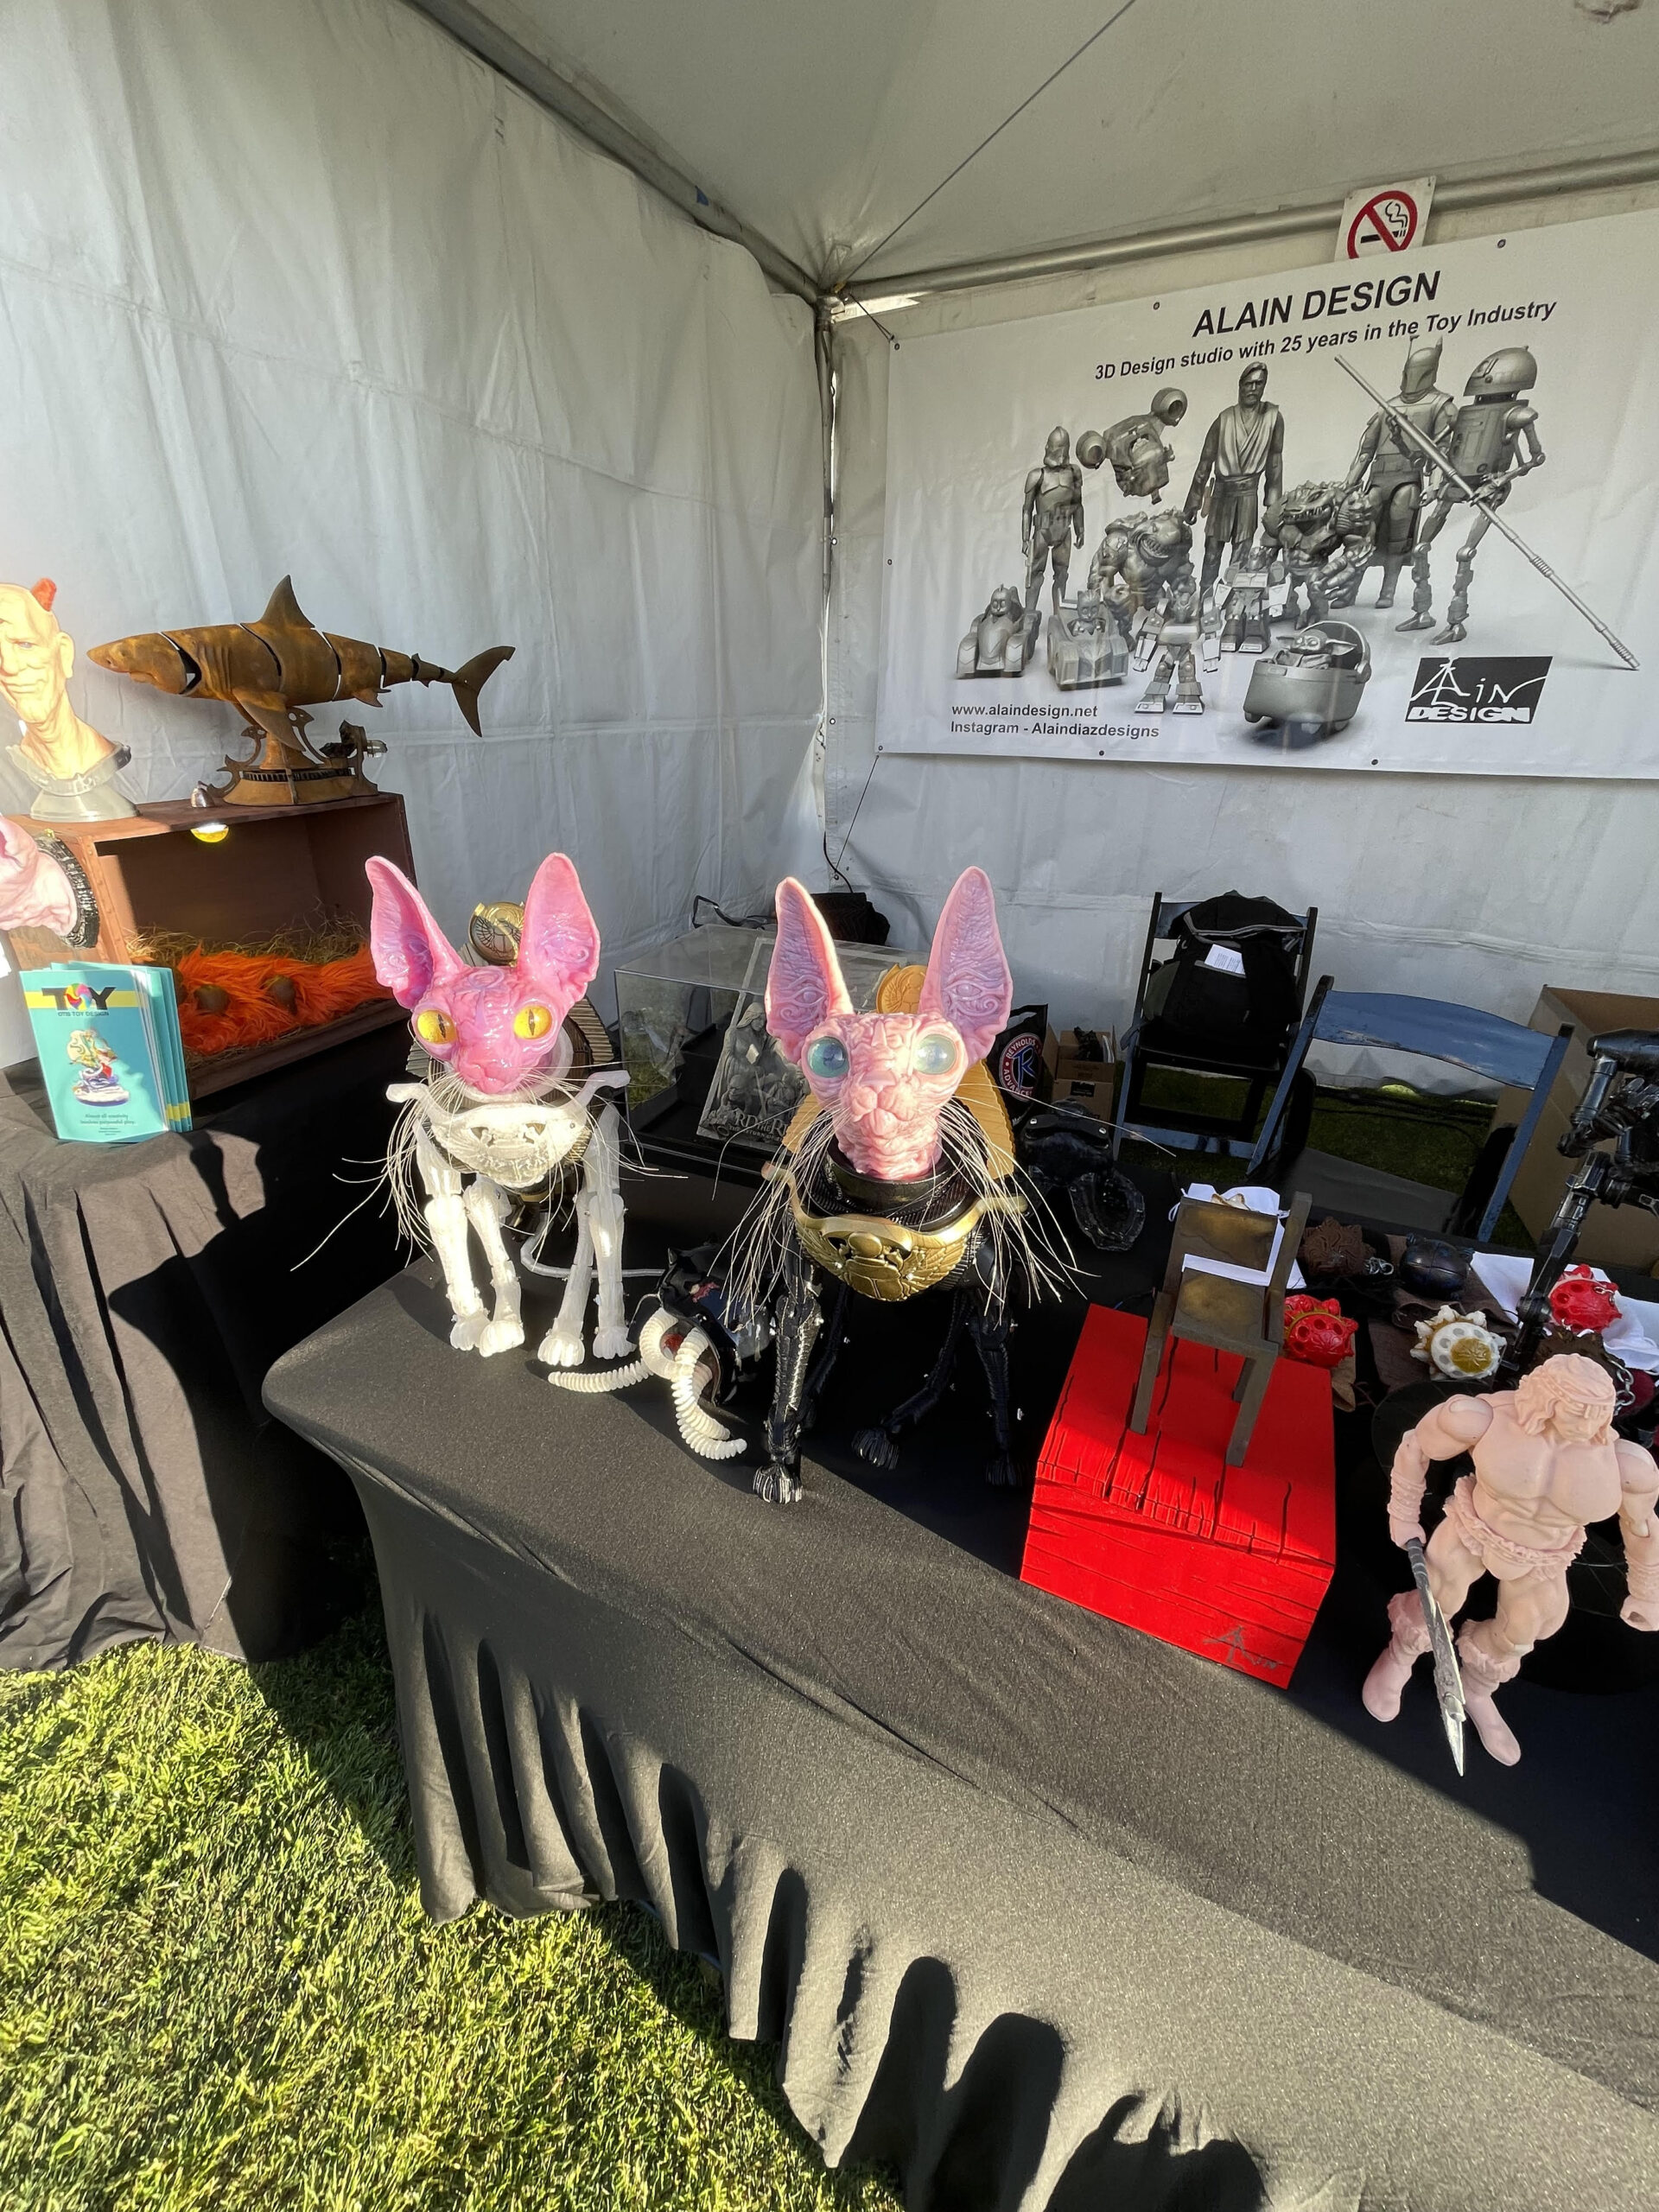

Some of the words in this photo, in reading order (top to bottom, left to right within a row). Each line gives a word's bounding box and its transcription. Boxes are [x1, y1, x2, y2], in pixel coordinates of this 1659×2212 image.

[1192, 296, 1293, 338] ALAIN
[1302, 270, 1441, 321] DESIGN
[1095, 365, 1116, 380] 3D
[1121, 358, 1175, 377] Design
[1180, 346, 1233, 367] studio
[1239, 340, 1275, 359] with
[1280, 335, 1303, 353] 25
[1306, 331, 1357, 353] years
[1363, 325, 1382, 340] in
[1388, 320, 1419, 338] the
[1427, 315, 1462, 334] Toy
[1467, 302, 1557, 327] Industry
[951, 703, 1098, 719] www.alaindesign.net
[1407, 706, 1530, 722] DESIGN
[950, 721, 1019, 736] Instagram
[1031, 721, 1160, 740] Alaindiazdesigns
[41, 983, 117, 1011] TOY
[1006, 1037, 1036, 1059] REYNOLDS
